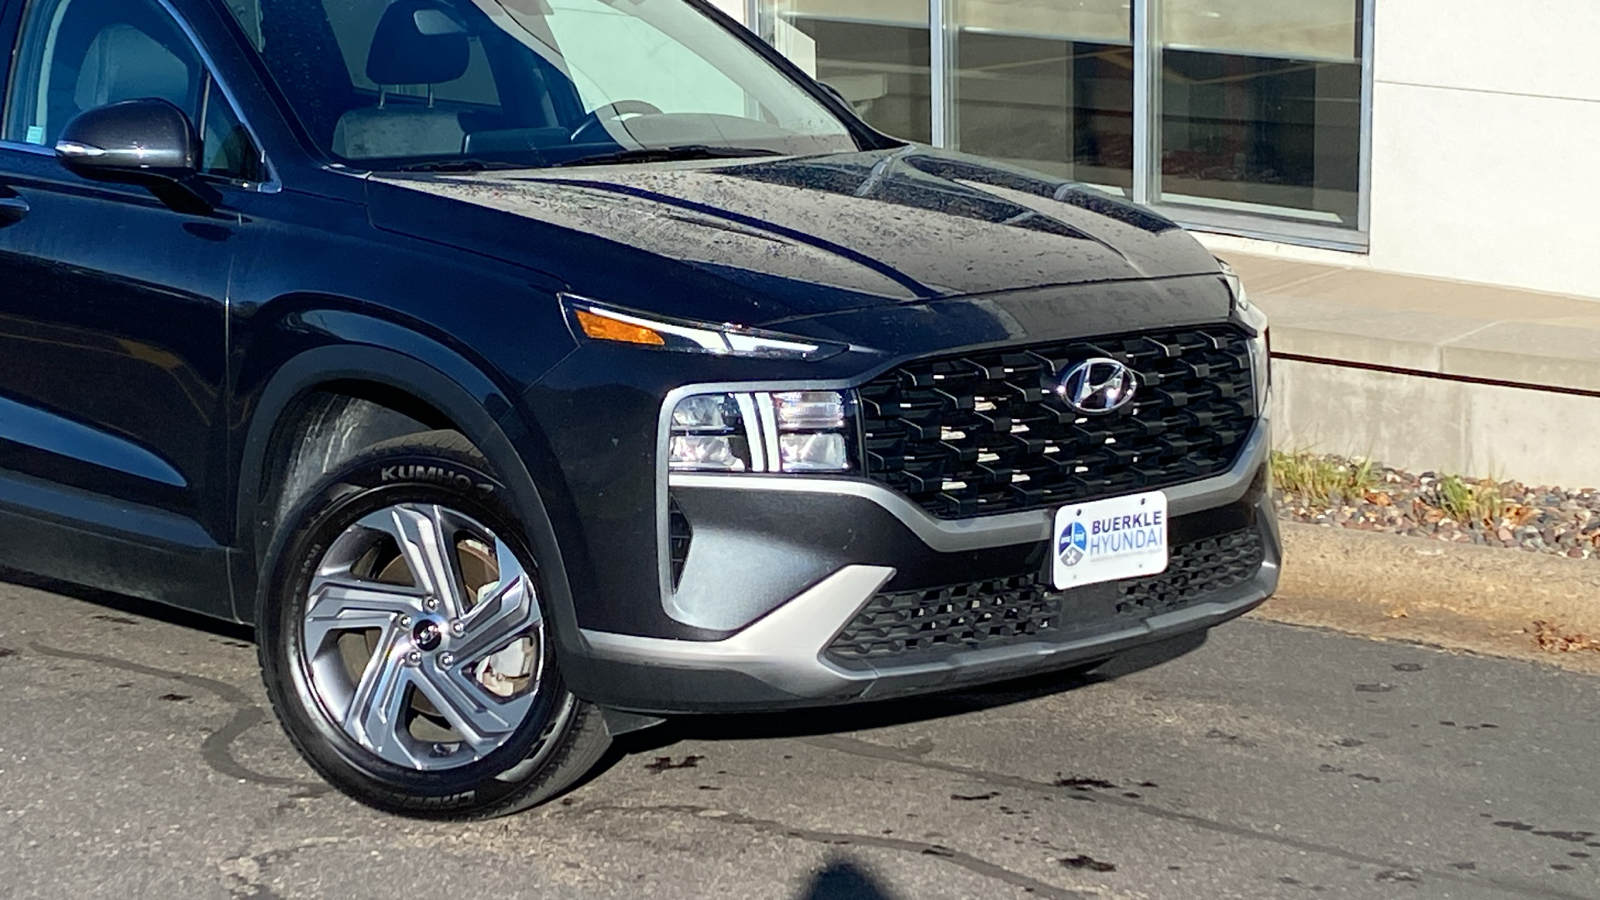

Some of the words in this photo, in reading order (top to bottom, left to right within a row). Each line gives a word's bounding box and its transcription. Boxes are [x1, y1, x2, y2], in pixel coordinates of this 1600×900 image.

[381, 465, 472, 487] KUMHO
[1091, 510, 1162, 535] BUERKLE
[1090, 527, 1162, 556] HYUNDAI
